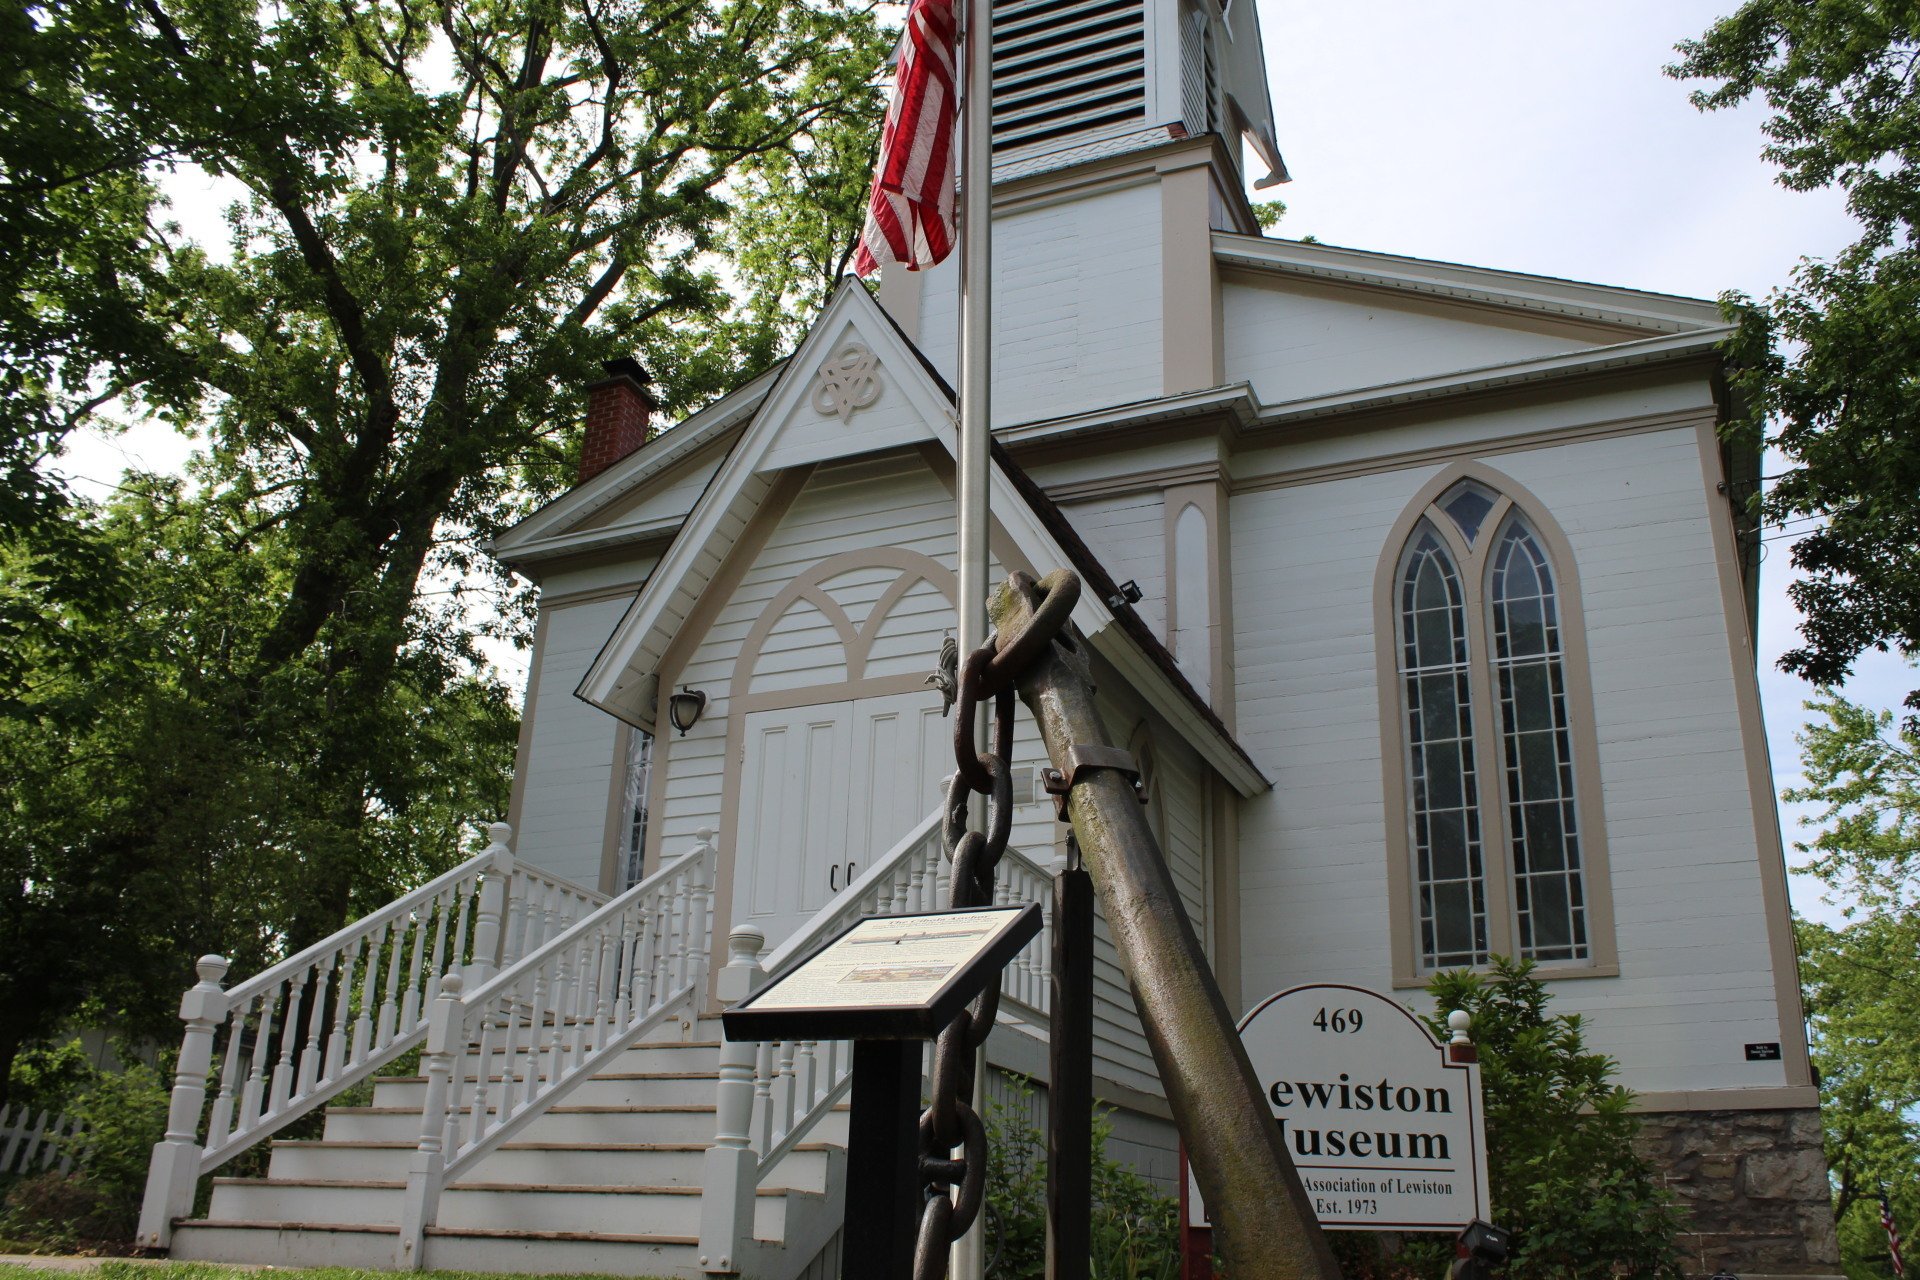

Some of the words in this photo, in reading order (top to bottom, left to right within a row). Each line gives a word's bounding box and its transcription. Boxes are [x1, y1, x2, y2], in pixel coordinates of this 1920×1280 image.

[1313, 1007, 1363, 1034] 469
[1264, 1073, 1453, 1114] ewiston
[1275, 1117, 1452, 1160] useum
[1304, 1176, 1376, 1194] Association
[1380, 1178, 1394, 1194] of
[1397, 1178, 1453, 1195] Lewiston
[1316, 1199, 1342, 1214] Est.
[1348, 1199, 1377, 1215] 1973
